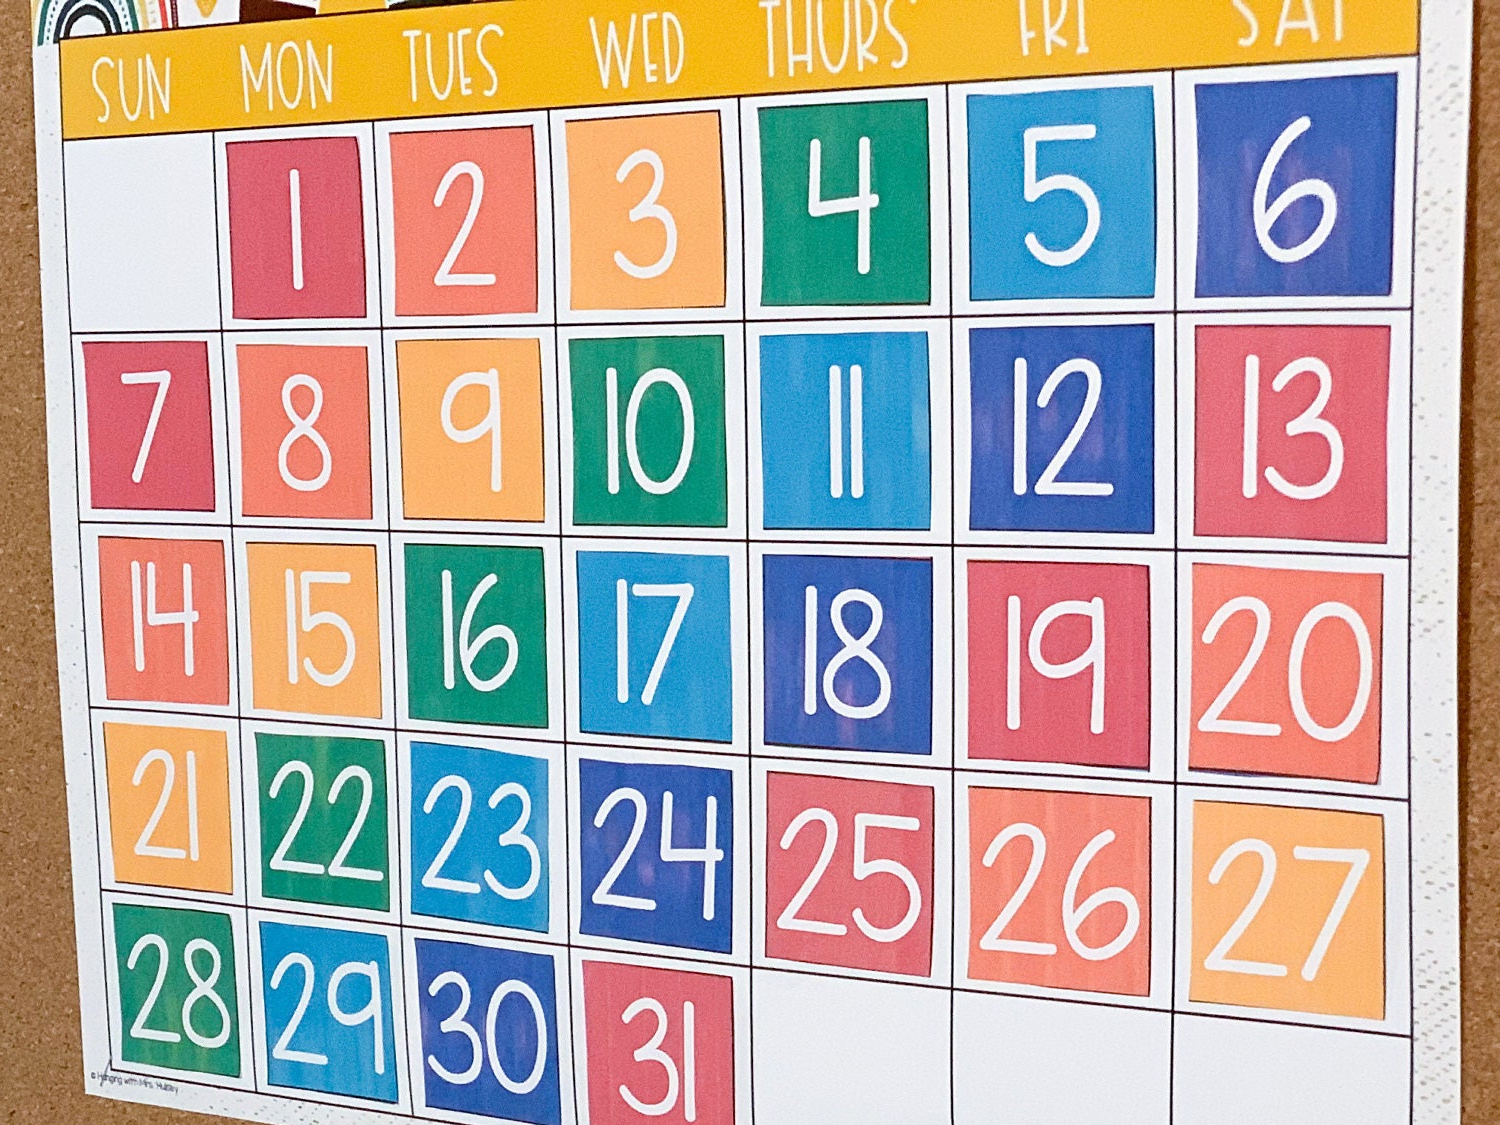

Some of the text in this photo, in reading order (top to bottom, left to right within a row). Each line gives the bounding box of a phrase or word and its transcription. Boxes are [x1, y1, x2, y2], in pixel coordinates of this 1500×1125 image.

[91, 53, 171, 122] SUN
[239, 39, 333, 113] MON
[402, 23, 504, 102] TUES
[589, 12, 684, 89] WED
[763, 0, 908, 77] THURS
[289, 116, 1337, 290] 1 2 3 4 5 6
[121, 354, 1344, 500] 7 8 9 10 11 12 13
[130, 560, 1373, 742] 14 15 16 17 18 19 20
[132, 749, 1371, 981] 21 22 23 24 25 26 27
[128, 933, 696, 1123] 28 29 30 31
